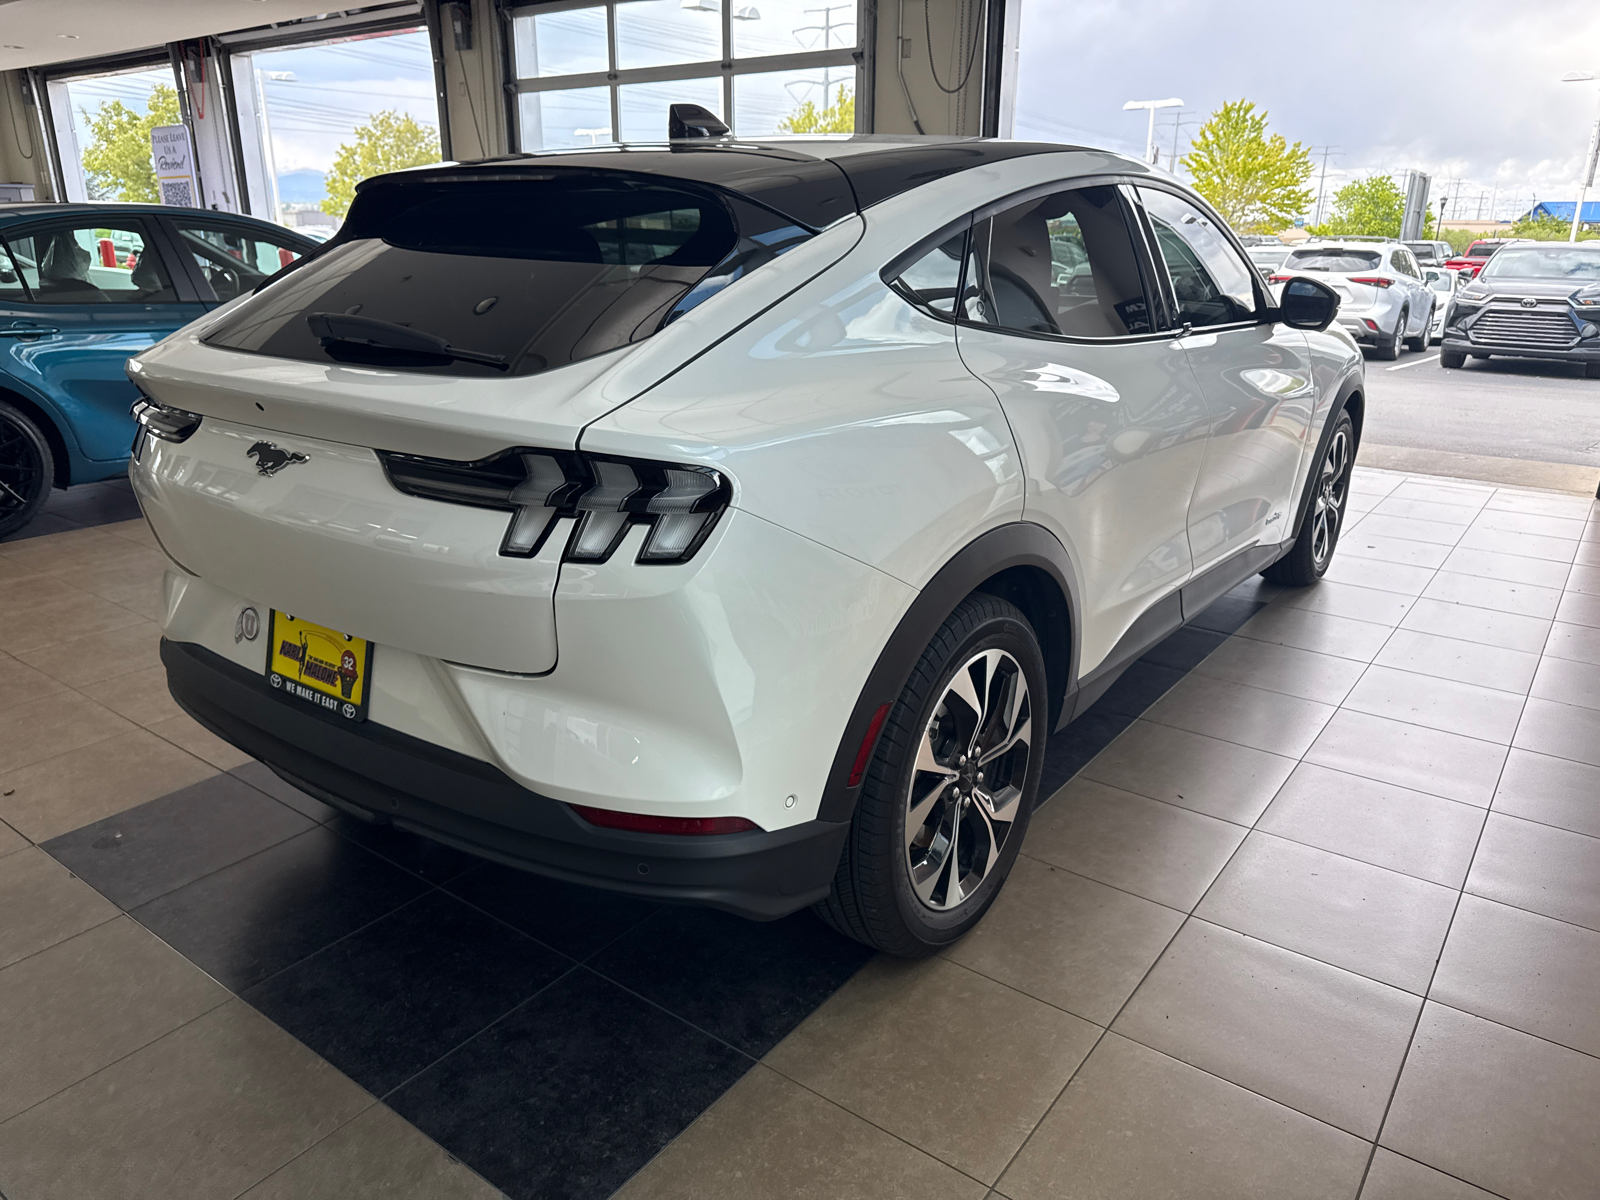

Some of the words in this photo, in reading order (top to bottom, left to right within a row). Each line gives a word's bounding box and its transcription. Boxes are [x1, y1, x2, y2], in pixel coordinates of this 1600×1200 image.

[152, 134, 170, 144] PLEASE
[170, 132, 185, 141] LEAVE
[343, 656, 354, 670] 32
[286, 681, 296, 693] WE
[296, 685, 314, 701] MAKE
[314, 693, 321, 704] IT
[321, 696, 338, 711] EASY
